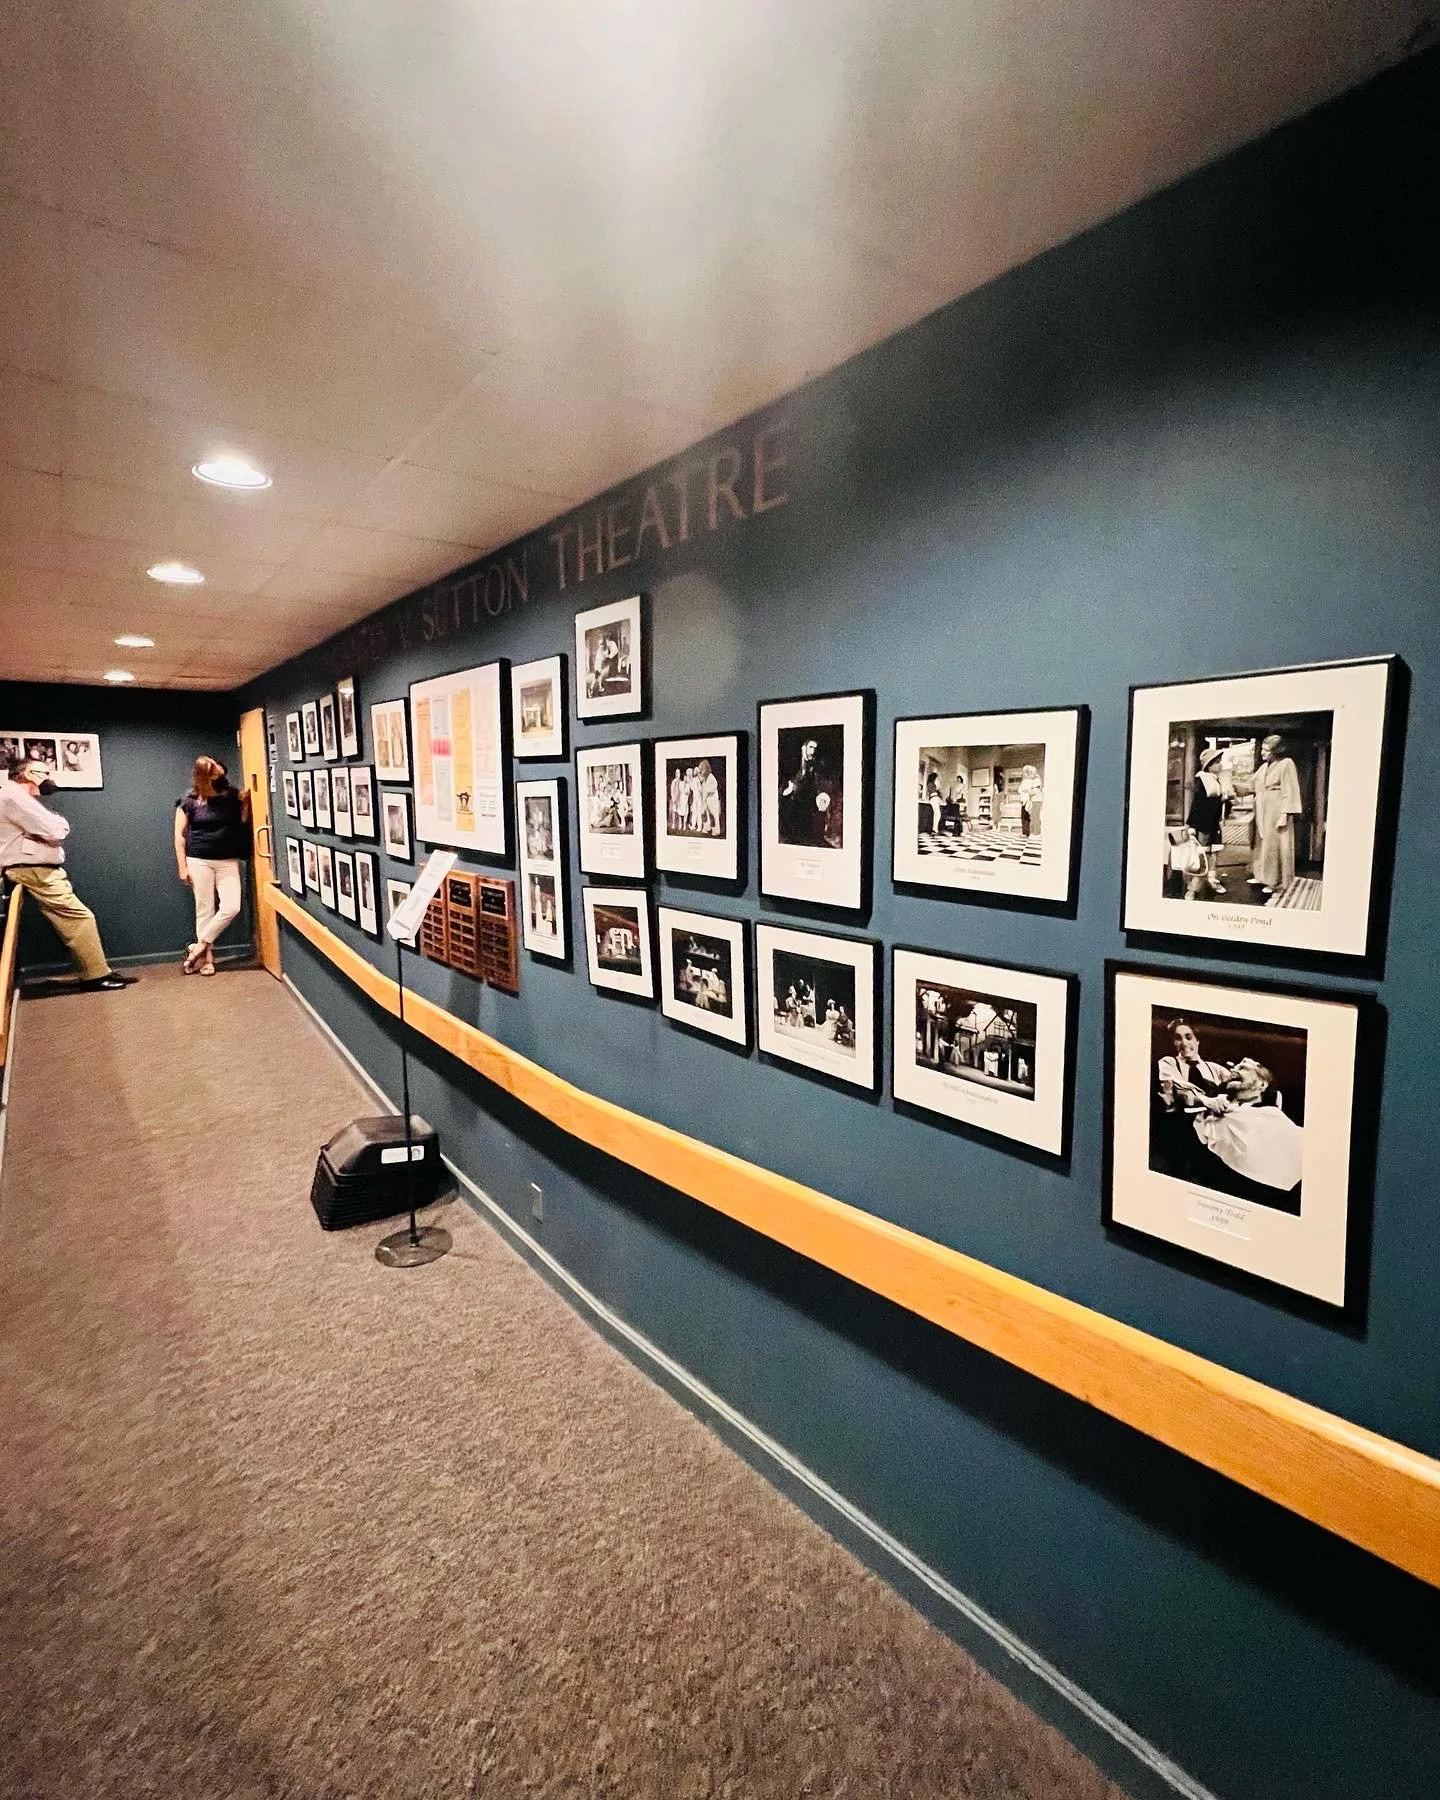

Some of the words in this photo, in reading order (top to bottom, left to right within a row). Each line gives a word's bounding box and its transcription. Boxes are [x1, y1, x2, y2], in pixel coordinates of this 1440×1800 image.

[420, 548, 528, 641] SUTTON
[550, 418, 789, 588] THEATRE
[1207, 912, 1219, 921] On
[1251, 916, 1273, 926] Pond
